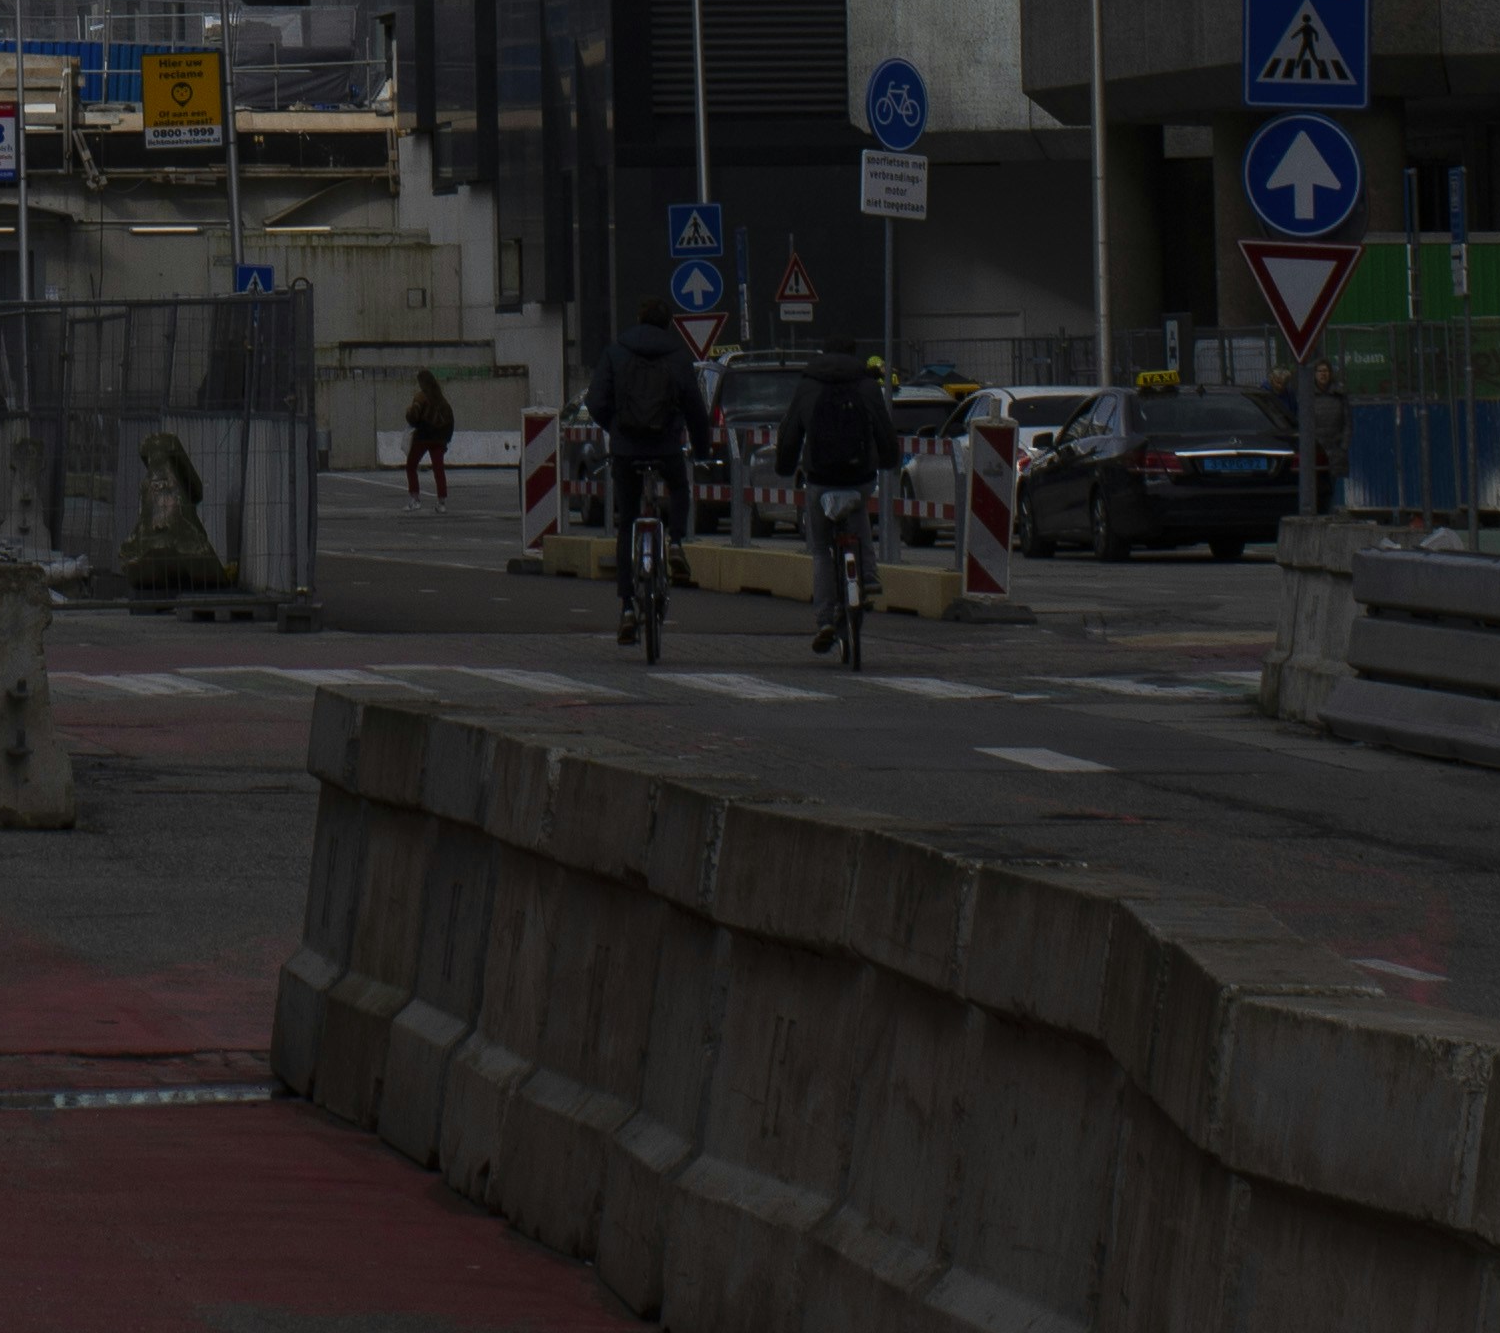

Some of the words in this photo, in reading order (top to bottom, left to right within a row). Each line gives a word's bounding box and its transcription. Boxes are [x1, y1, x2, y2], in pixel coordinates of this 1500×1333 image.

[158, 59, 183, 68] Hier
[159, 69, 204, 79] reclame
[866, 155, 910, 168] snorfietsen
[911, 160, 926, 171] met
[885, 186, 908, 197] motor
[866, 197, 882, 209] niet
[883, 199, 925, 212] toegestaan
[1354, 350, 1386, 364] bam
[1145, 373, 1176, 384] TAXI
